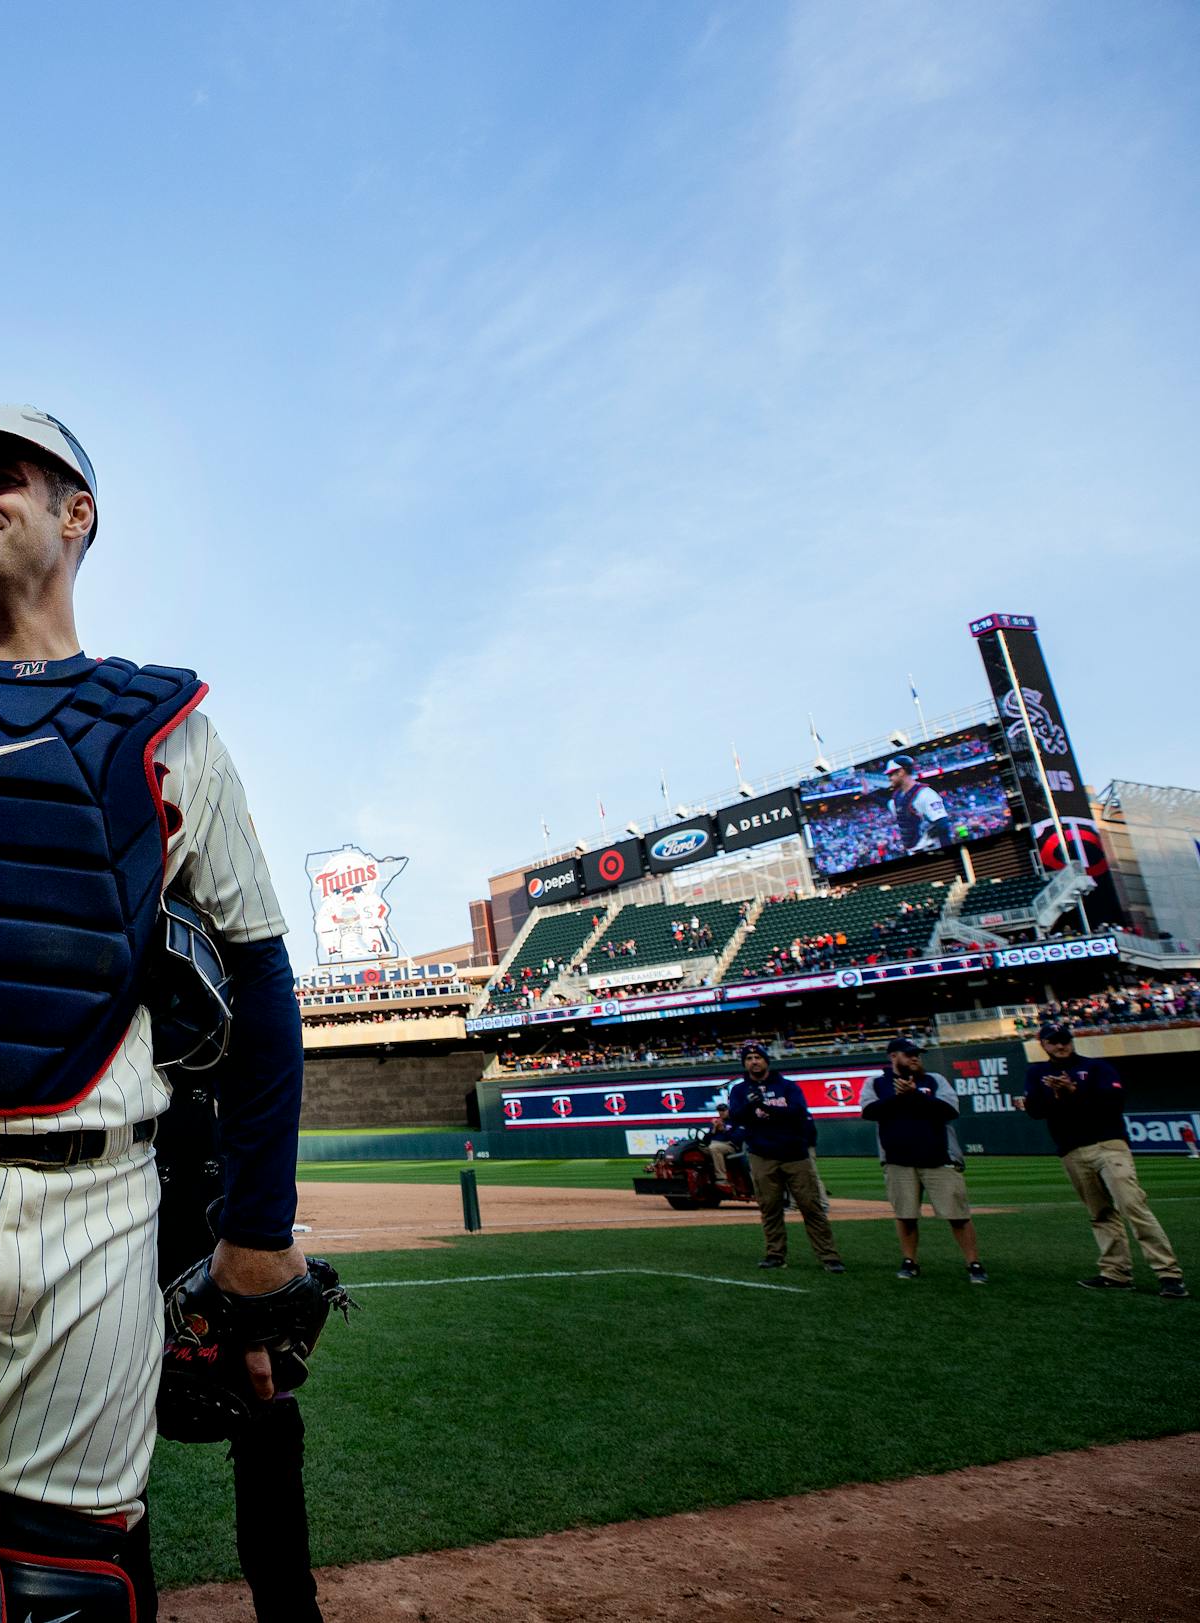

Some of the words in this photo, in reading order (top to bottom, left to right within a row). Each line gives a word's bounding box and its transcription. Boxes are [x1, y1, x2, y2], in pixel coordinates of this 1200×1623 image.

[739, 806, 793, 832] DELTA
[661, 836, 697, 856] Ford
[315, 864, 377, 898] Twins
[543, 869, 575, 893] pepsi
[385, 963, 457, 981] FIELD
[622, 1010, 661, 1023] TREASURE
[665, 1007, 696, 1018] ISLAND
[700, 1004, 722, 1014] COVE
[979, 1057, 1008, 1076] WE
[955, 1076, 1000, 1096] BASE
[973, 1093, 1016, 1113] BALL
